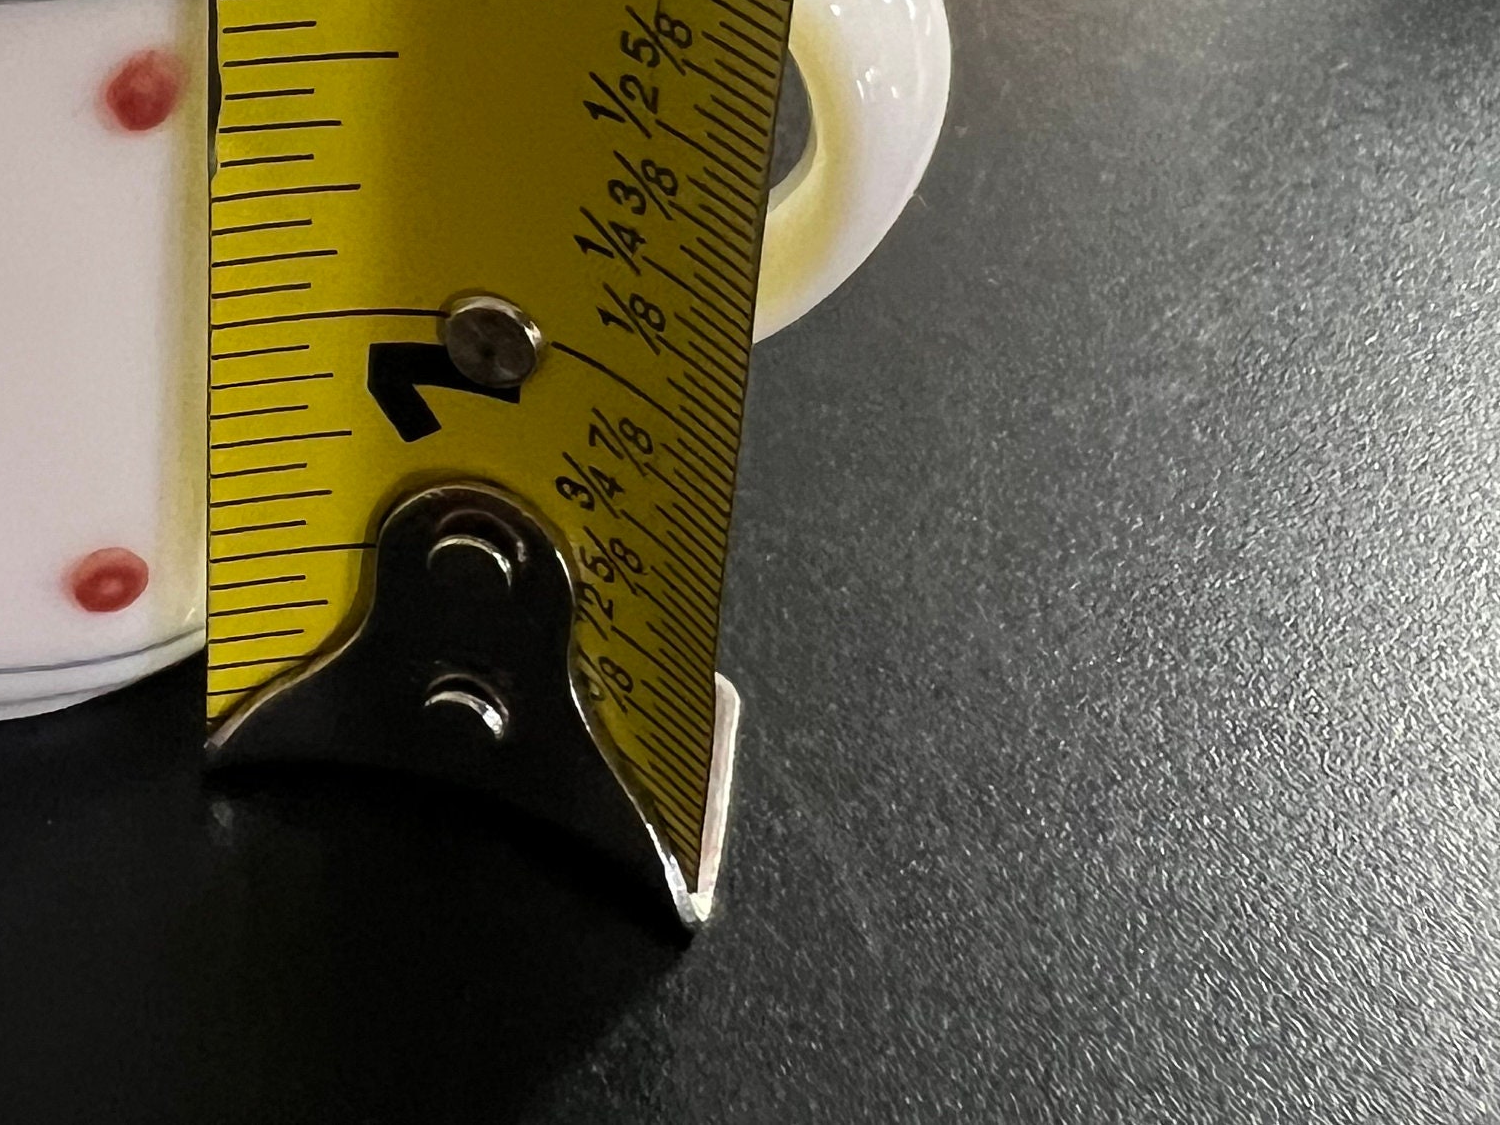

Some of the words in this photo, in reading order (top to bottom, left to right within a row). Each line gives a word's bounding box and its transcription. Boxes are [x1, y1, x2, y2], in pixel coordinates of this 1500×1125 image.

[620, 5, 693, 76] 5/8
[583, 71, 659, 139] 1/2
[607, 149, 679, 221] 3/8
[573, 206, 647, 276] 1/4
[596, 281, 666, 356] 1/8
[367, 341, 521, 443] 1
[589, 407, 653, 477] 7/8
[555, 451, 625, 519] 3/4
